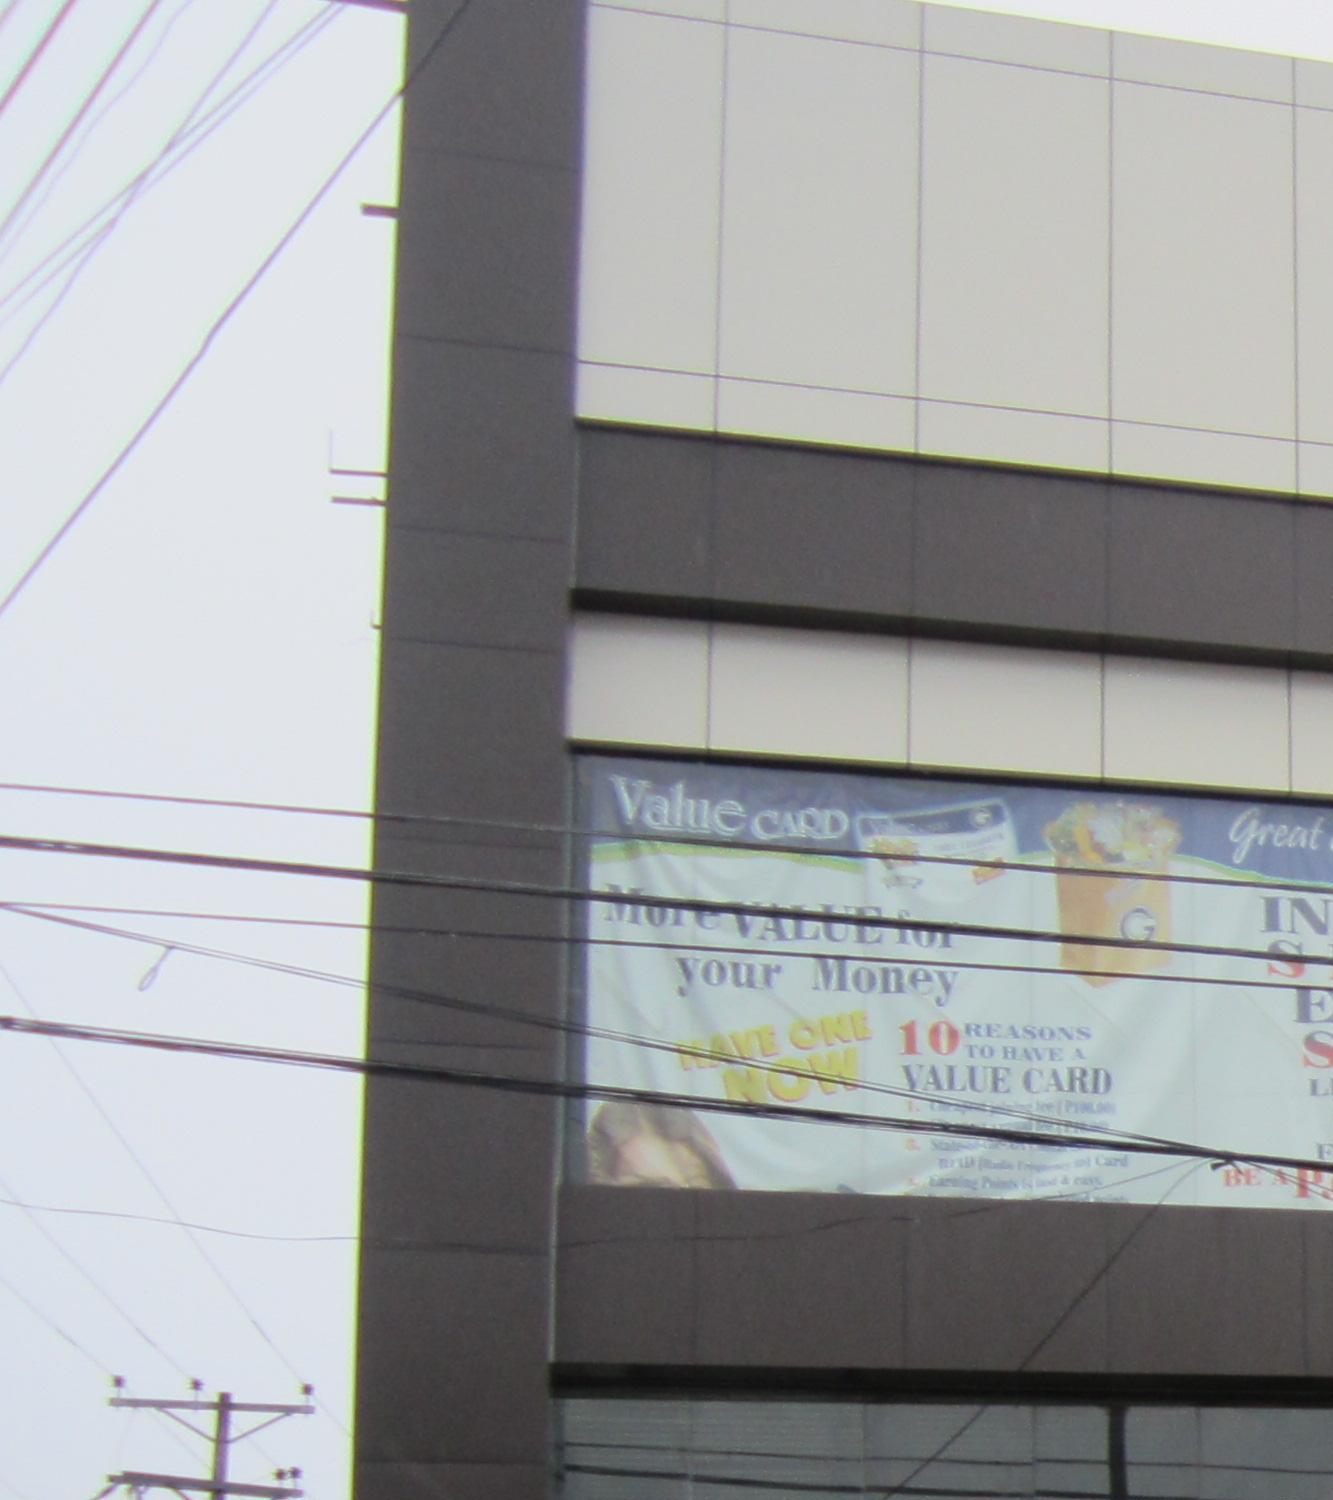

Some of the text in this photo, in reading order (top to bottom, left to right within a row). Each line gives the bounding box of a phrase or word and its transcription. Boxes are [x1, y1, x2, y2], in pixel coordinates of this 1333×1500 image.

[610, 774, 849, 840] Value CARD
[1228, 808, 1325, 864] Great
[603, 882, 721, 931] More
[734, 900, 883, 945] VALUE
[676, 954, 959, 1007] your Money
[677, 1008, 873, 1072] HAVE ONE
[898, 1020, 1093, 1057] 10 REASONS
[965, 1043, 1087, 1062] TO HAVE A
[721, 1047, 860, 1104] NOW
[902, 1063, 1113, 1096] VALUE CARD
